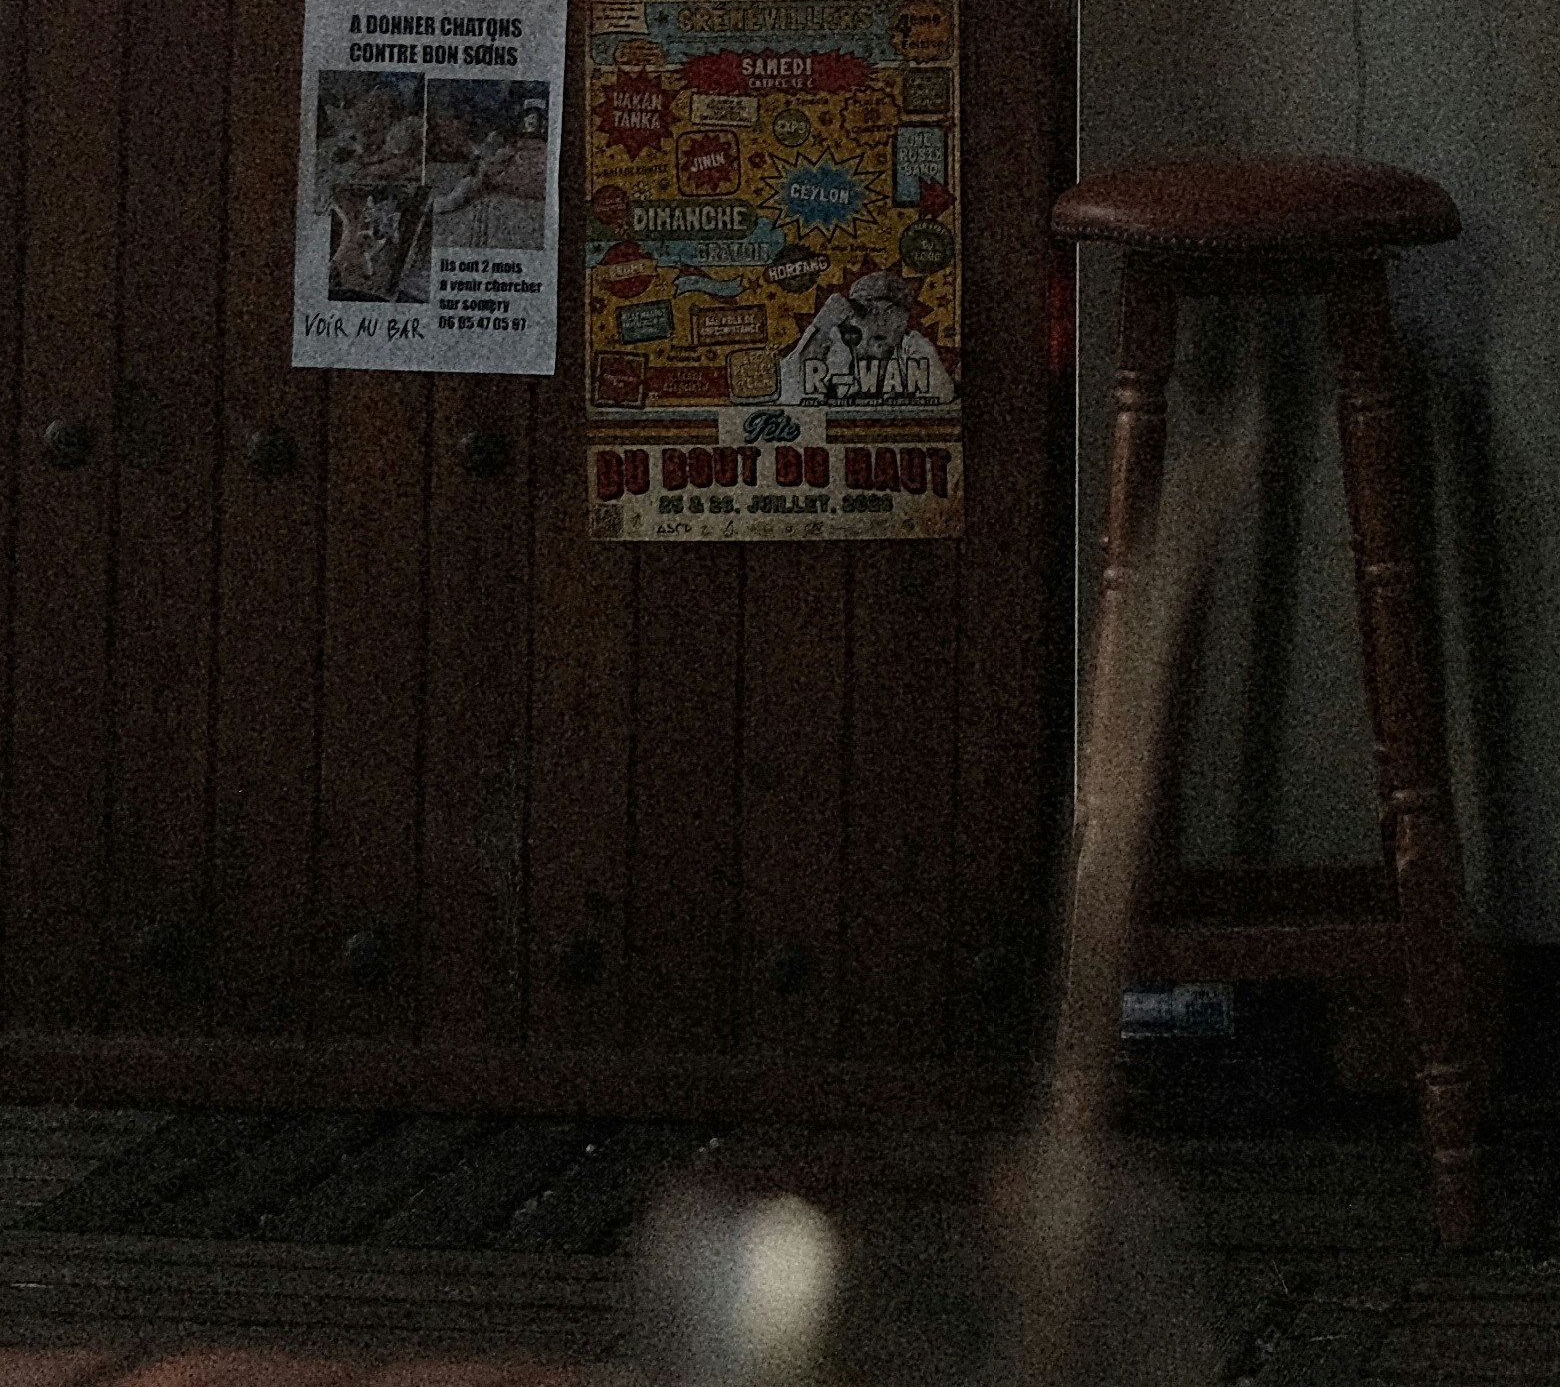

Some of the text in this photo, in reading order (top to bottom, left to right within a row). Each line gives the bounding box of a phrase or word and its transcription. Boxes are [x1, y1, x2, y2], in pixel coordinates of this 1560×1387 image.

[349, 14, 523, 42] A DONNER CHATONS
[349, 42, 419, 64] CONTRE
[423, 44, 459, 65] BON
[741, 57, 813, 76] SAMEDI
[789, 182, 852, 205] CEYLON
[633, 205, 749, 232] DIMANCHE
[440, 258, 523, 274] Ils ont 2 mois
[450, 278, 482, 292] venir
[439, 298, 460, 310] sur
[305, 313, 425, 341] VOIR AU BAR
[439, 315, 456, 329] 06
[493, 317, 509, 330] 05
[743, 408, 801, 444] Fête
[595, 446, 953, 502] DU BOUT DU HAUT
